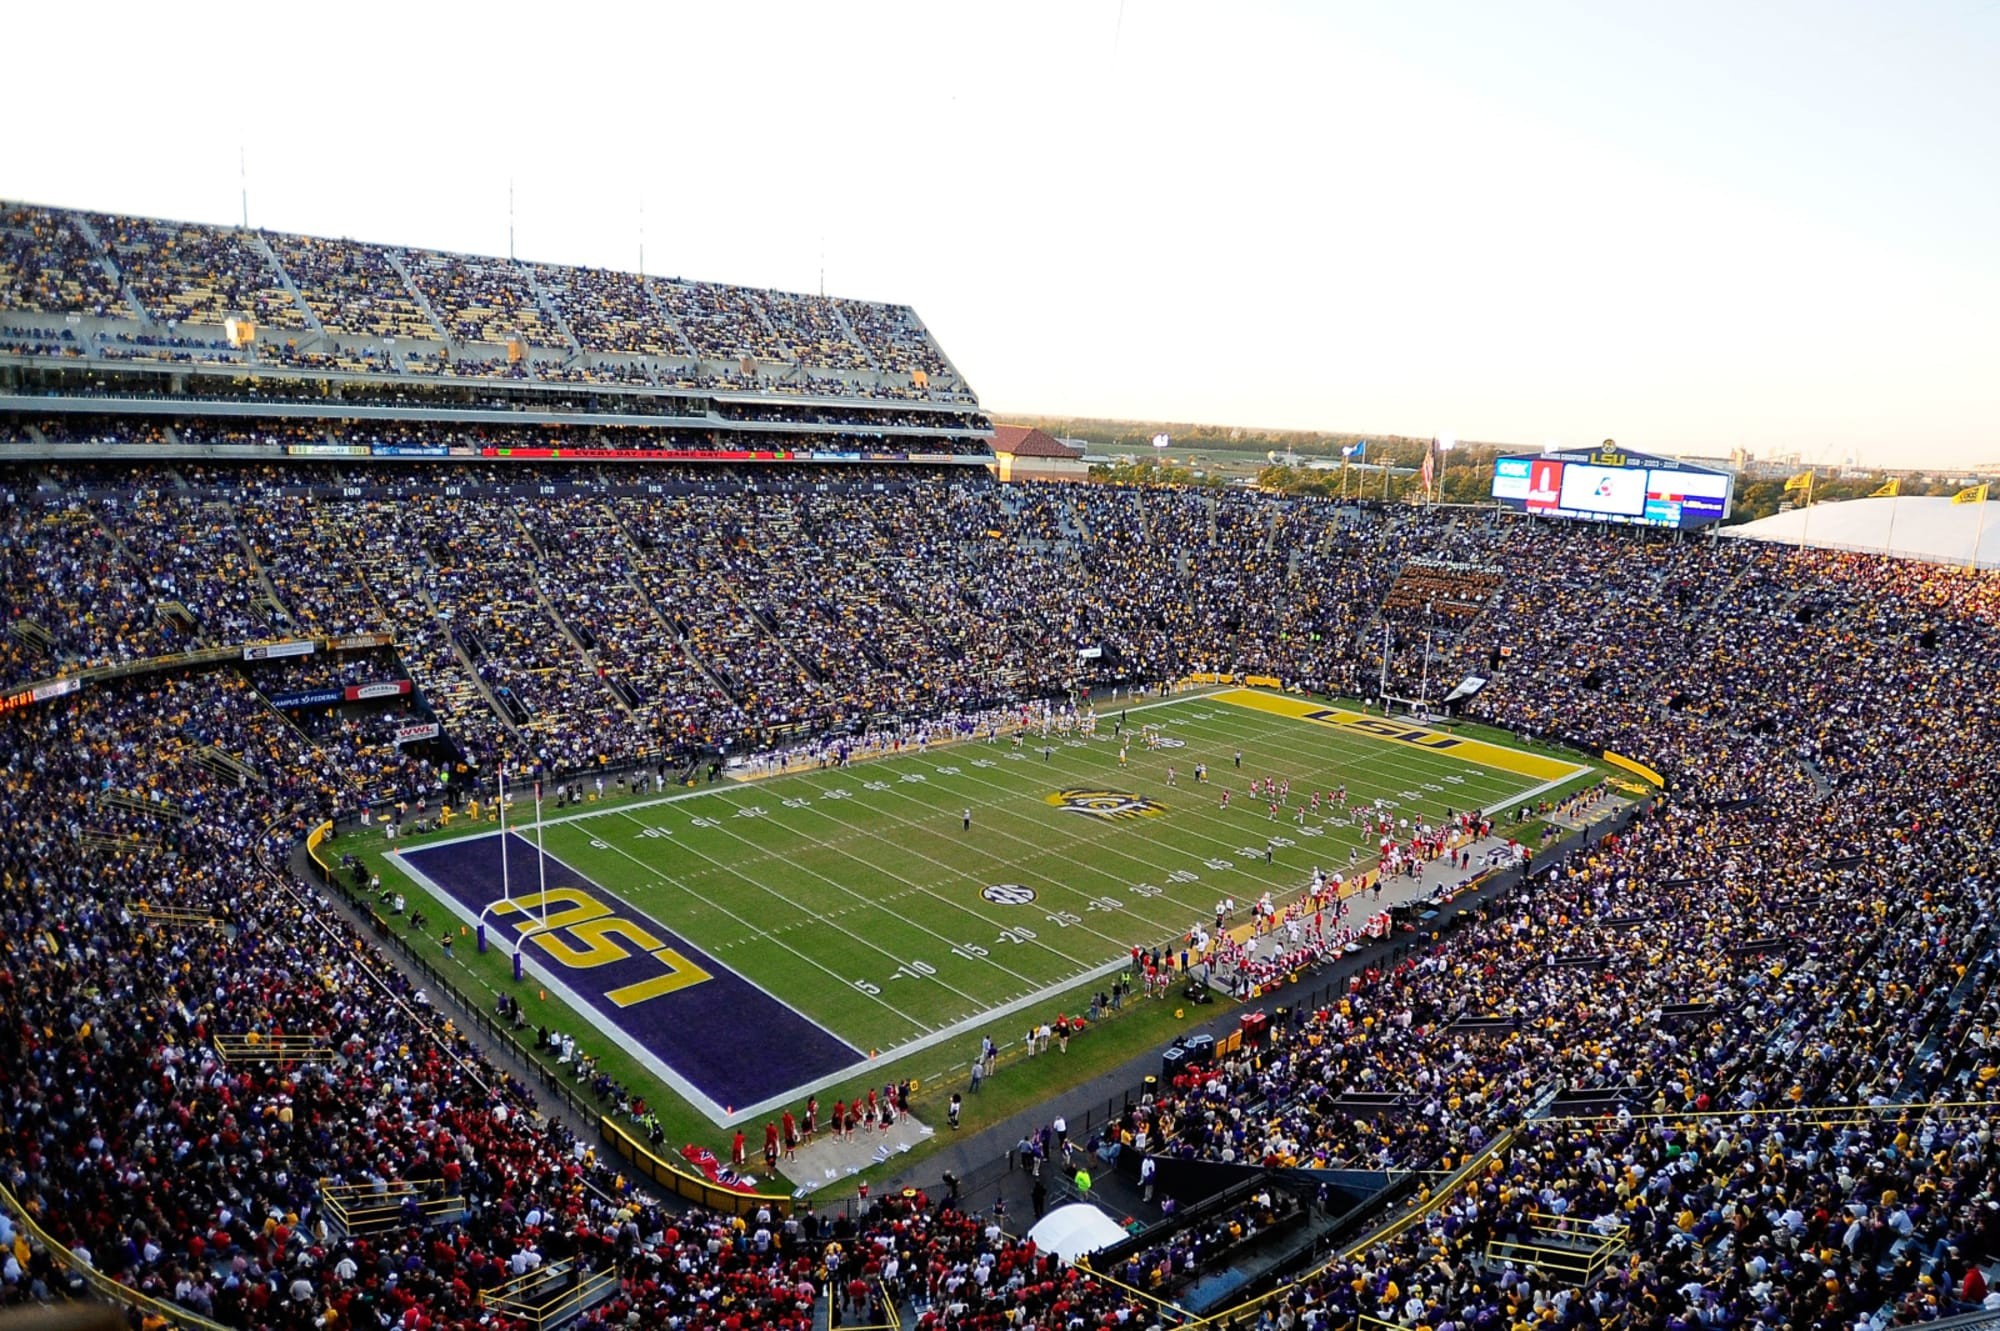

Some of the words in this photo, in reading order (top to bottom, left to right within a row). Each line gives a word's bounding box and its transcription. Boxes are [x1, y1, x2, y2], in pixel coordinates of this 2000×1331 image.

[1590, 453, 1626, 467] LSU
[343, 487, 361, 496] 100
[445, 487, 460, 496] 101
[540, 486, 555, 494] 102
[648, 485, 662, 493] 103
[310, 694, 338, 702] FEDERAL
[400, 725, 433, 736] WWL
[1302, 710, 1463, 749] LSU
[738, 806, 768, 818] 20
[691, 816, 721, 828] 15
[643, 826, 673, 839] 10
[590, 839, 608, 850] 5
[1168, 870, 1200, 884] 40
[1129, 883, 1164, 898] 35
[1089, 896, 1124, 912] 30
[1046, 911, 1083, 928] 25
[999, 926, 1038, 944] 20
[486, 887, 714, 1009] LSU
[951, 943, 990, 960] 15
[898, 960, 937, 979] 10
[854, 979, 881, 995] 5
